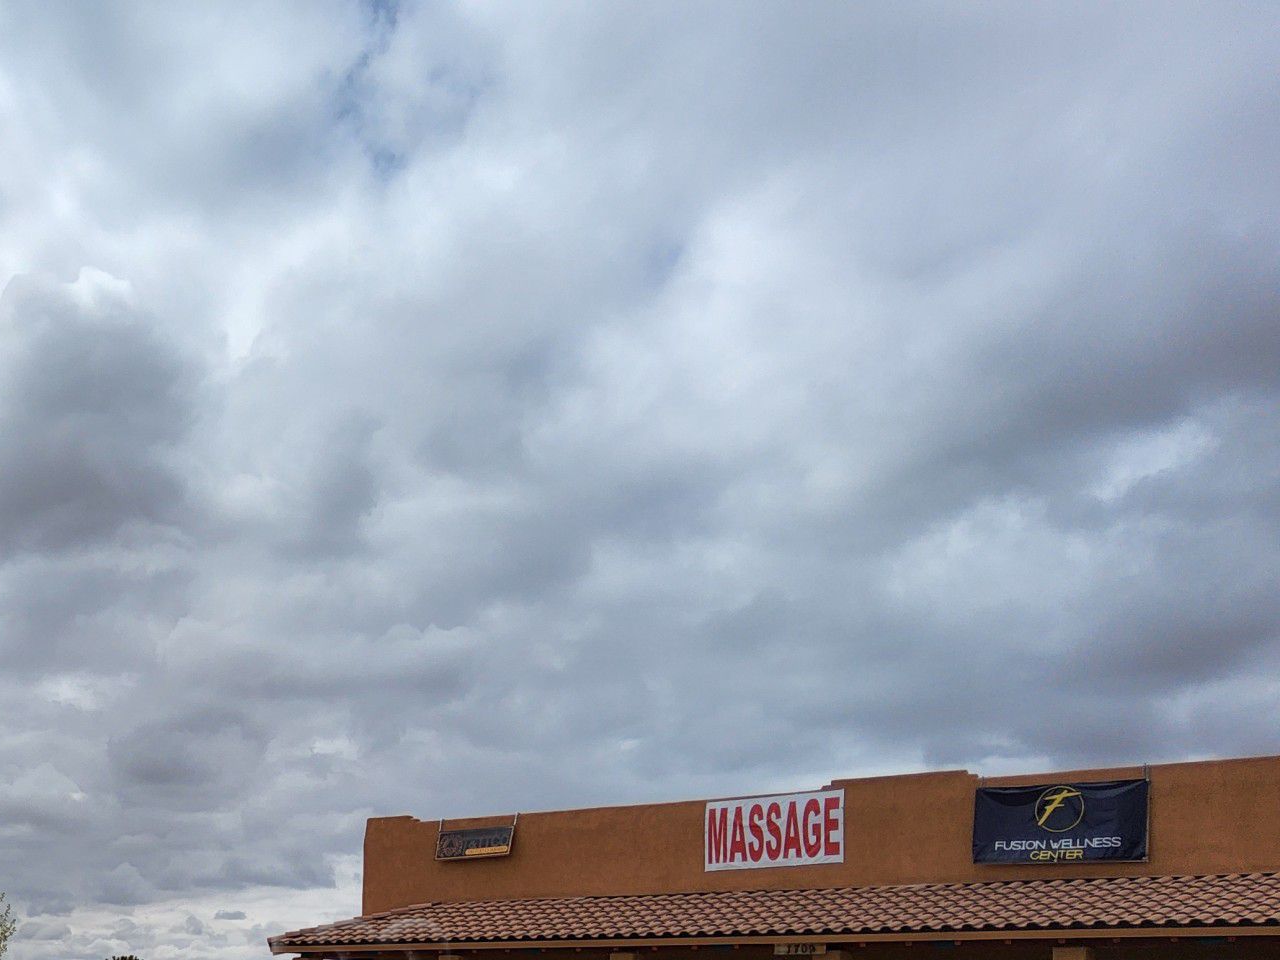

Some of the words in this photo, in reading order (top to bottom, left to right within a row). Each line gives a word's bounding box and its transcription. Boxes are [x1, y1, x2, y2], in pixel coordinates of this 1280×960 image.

[707, 796, 841, 865] MASSAGE
[994, 840, 1047, 851] FUSION
[1050, 837, 1122, 849] WELLNESS
[1029, 850, 1083, 860] CENTER
